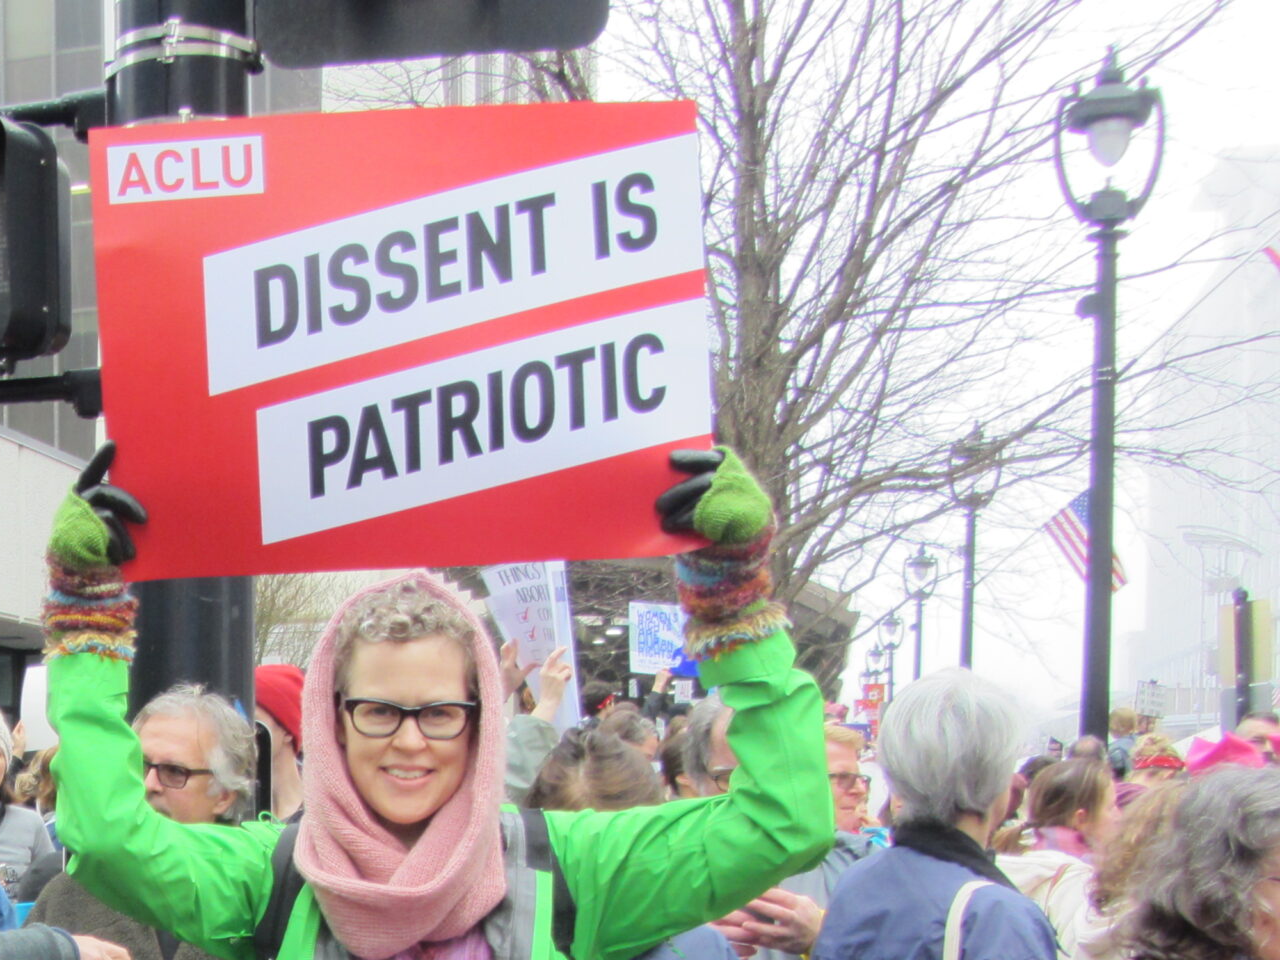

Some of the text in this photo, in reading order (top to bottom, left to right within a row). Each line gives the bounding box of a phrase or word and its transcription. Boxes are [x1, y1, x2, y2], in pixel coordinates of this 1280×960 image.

[117, 144, 254, 196] ACLU
[253, 172, 657, 349] DISSENT IS
[306, 333, 667, 499] PATRIOTIC
